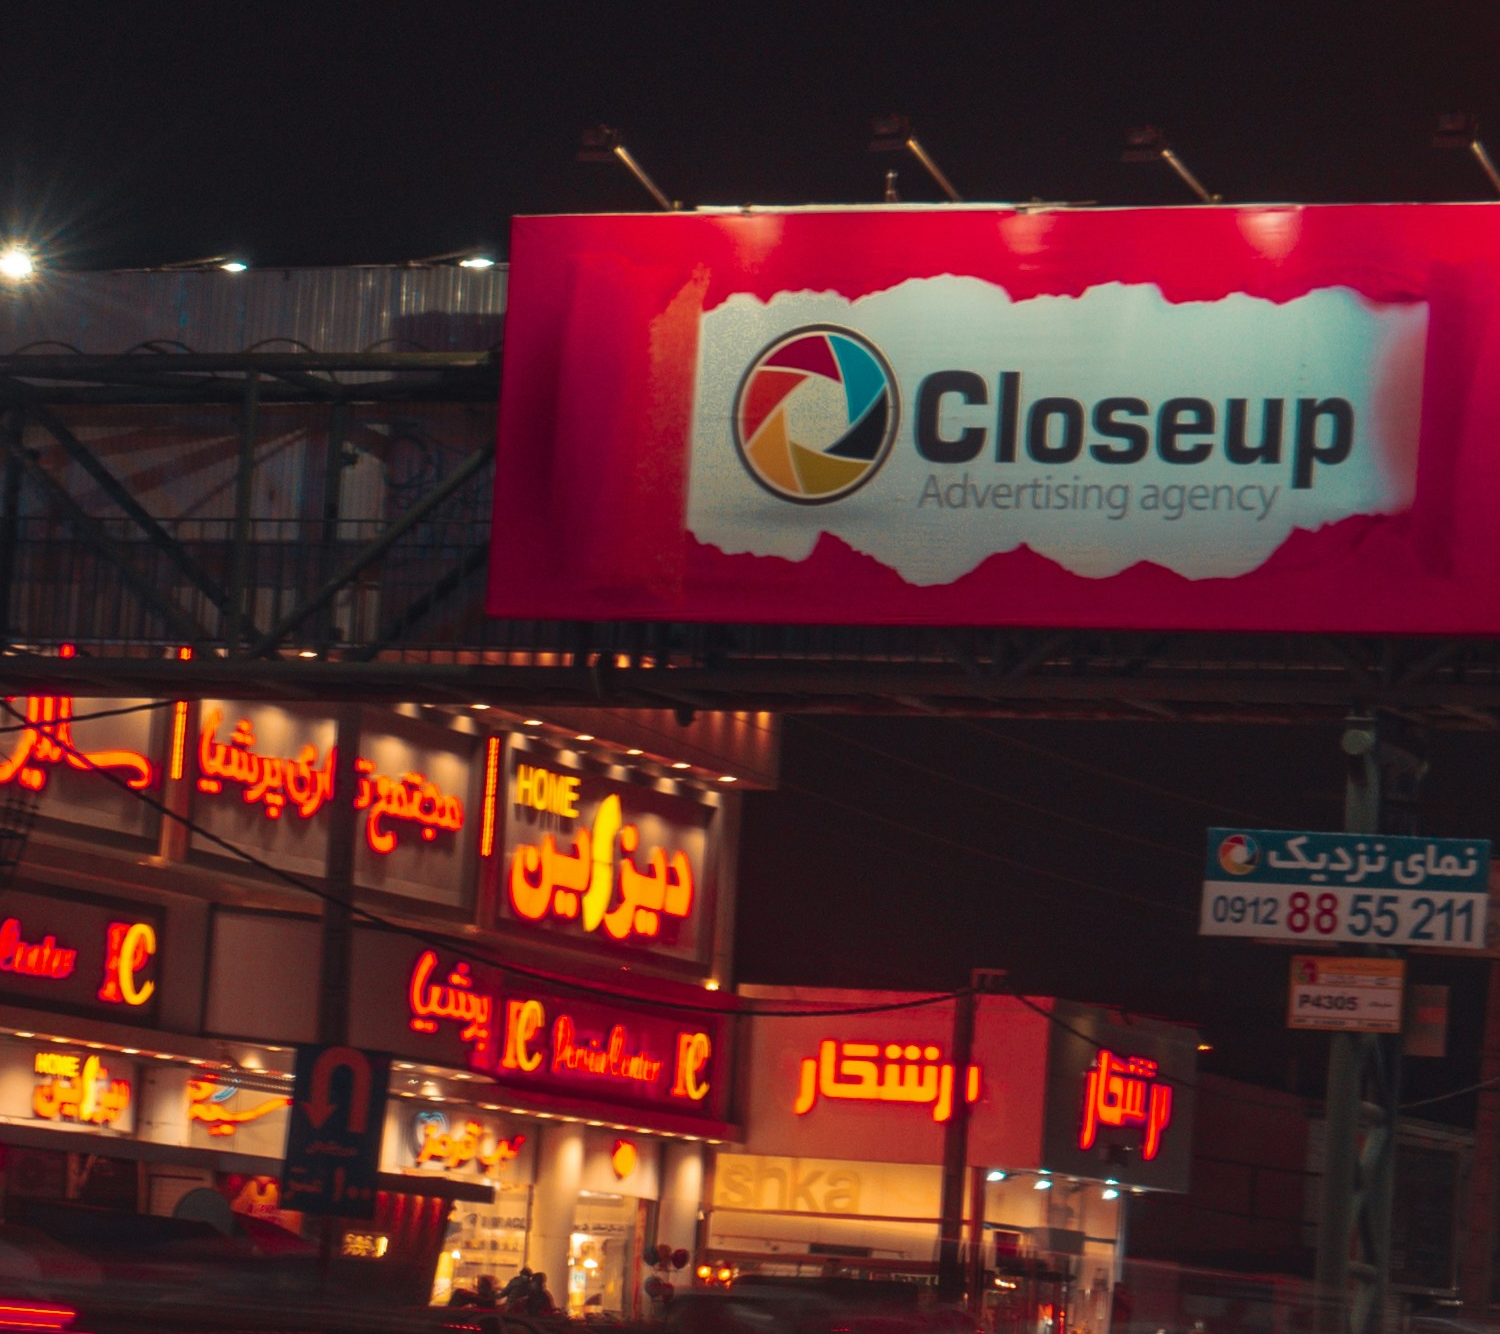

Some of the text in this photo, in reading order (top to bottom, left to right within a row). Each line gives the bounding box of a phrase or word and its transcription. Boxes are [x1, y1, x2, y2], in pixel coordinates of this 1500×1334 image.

[915, 369, 1356, 490] Closeup
[917, 472, 1279, 523] Advertising agency
[514, 763, 582, 819] HOME
[509, 792, 692, 941] دیزاین
[1267, 834, 1479, 886] نمای نزدیک
[1211, 894, 1278, 926] 0912
[1286, 890, 1339, 936] 88
[1347, 893, 1401, 939] 55
[1409, 897, 1476, 943] 211
